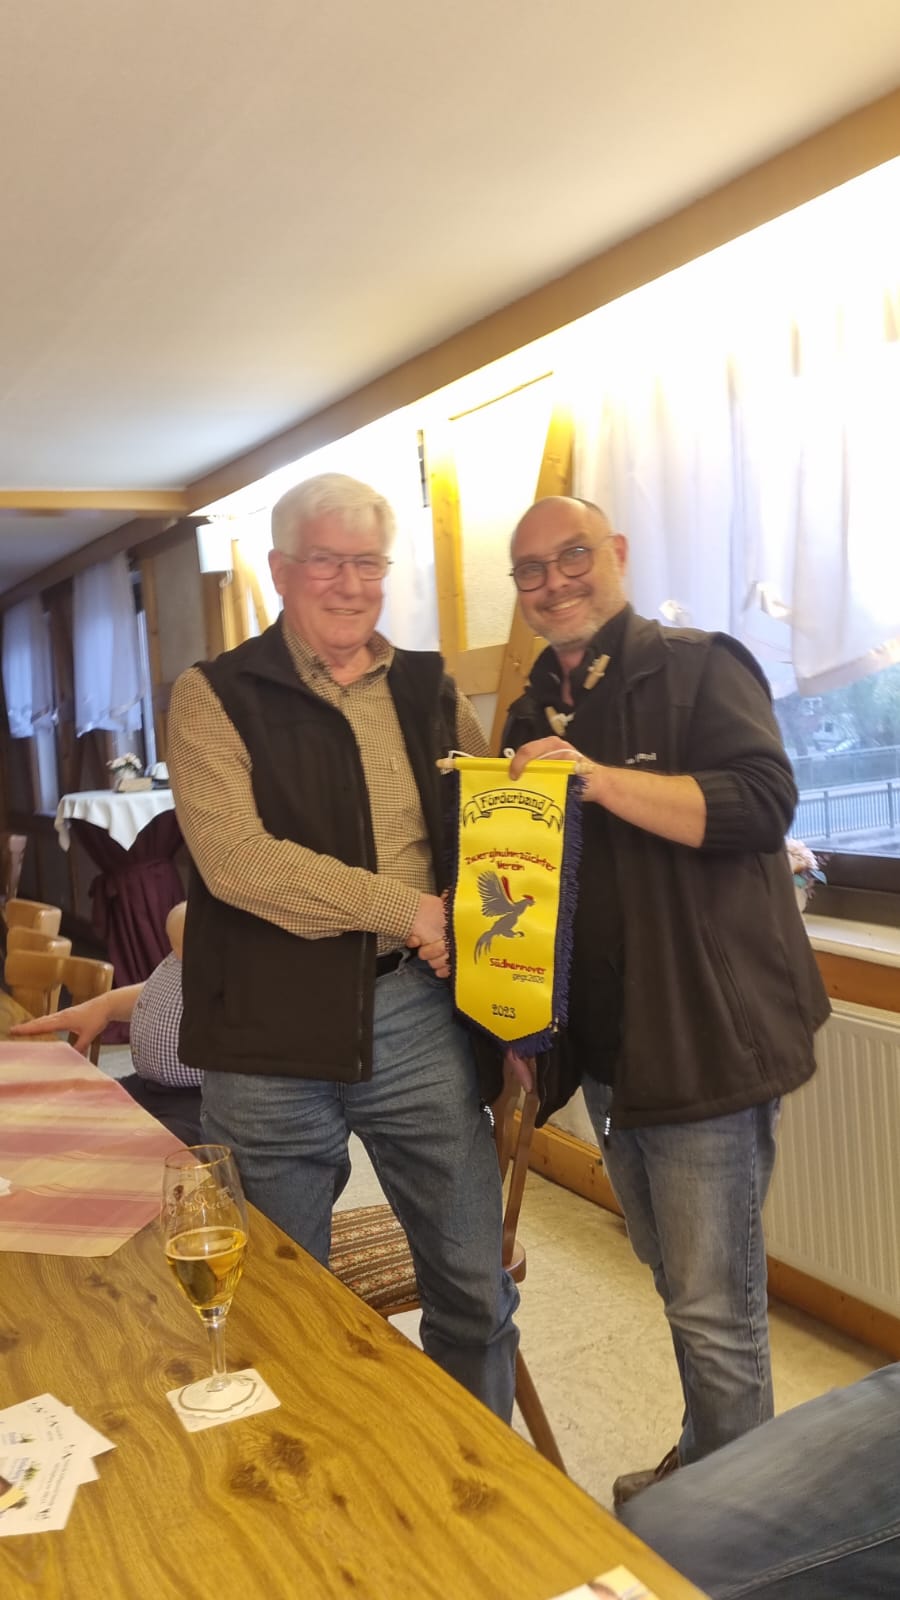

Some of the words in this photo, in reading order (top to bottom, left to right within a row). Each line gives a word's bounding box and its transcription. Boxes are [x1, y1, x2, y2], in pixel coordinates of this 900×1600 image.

[480, 792, 546, 810] Förderband
[496, 860, 525, 871] Verein
[491, 1003, 517, 1019] 2023
